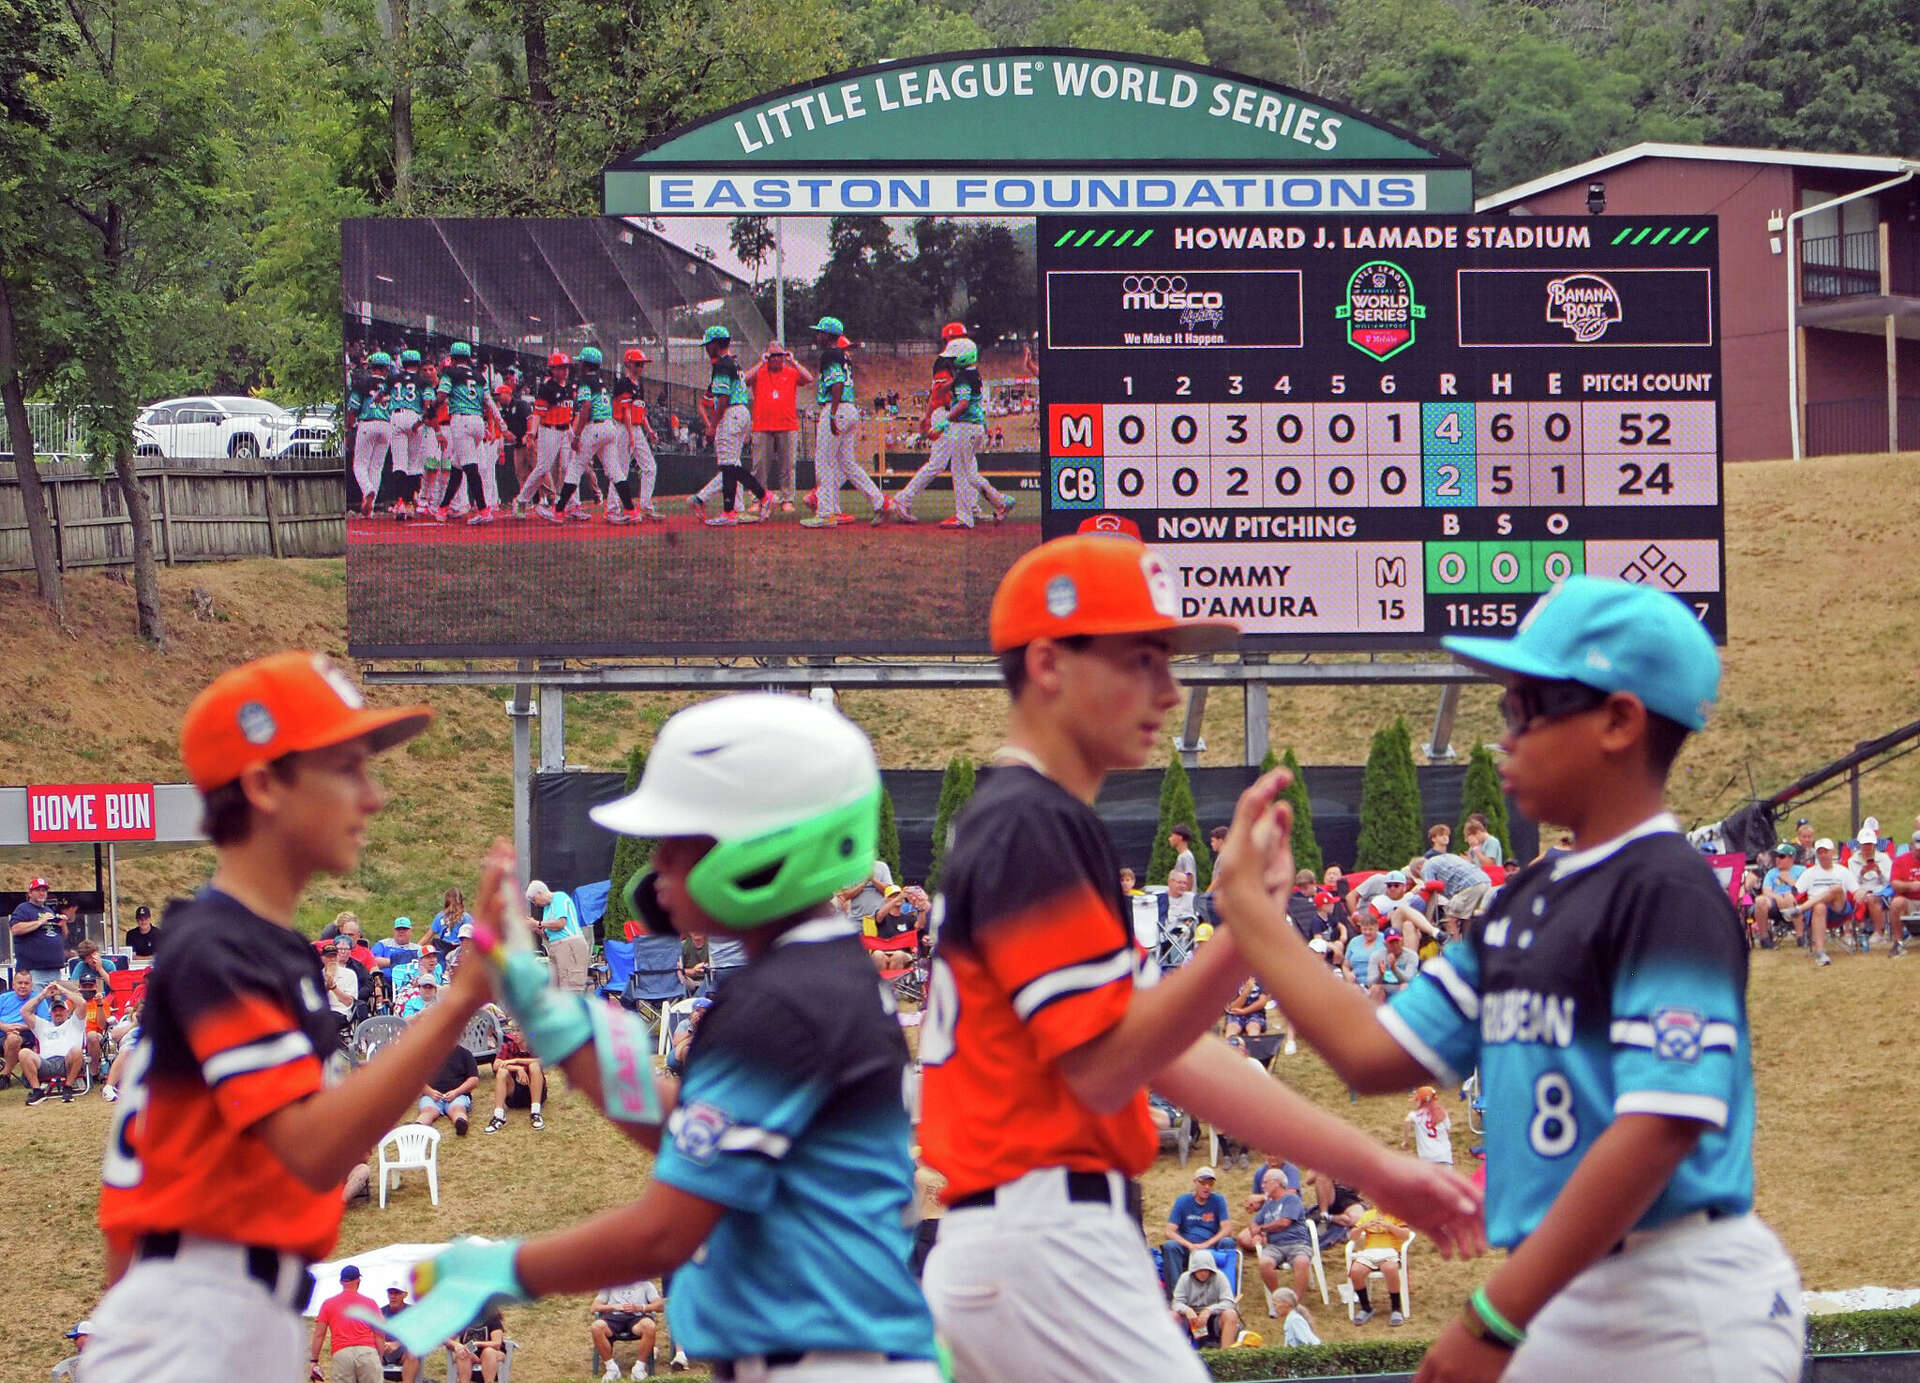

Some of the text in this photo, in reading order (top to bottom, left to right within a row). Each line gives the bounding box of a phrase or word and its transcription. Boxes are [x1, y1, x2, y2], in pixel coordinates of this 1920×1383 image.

[734, 83, 866, 154] LITTLE
[1053, 62, 1198, 109] WORLD
[1208, 83, 1342, 151] SERIES
[660, 178, 1415, 208] EASTON FOUNDATIONS
[1174, 226, 1591, 249] HOWARD J. LAMADE STADIUM
[1351, 295, 1409, 308] WORLD
[1551, 284, 1613, 305] BANANA
[1353, 309, 1408, 322] SERIES
[1124, 333, 1141, 344] We
[1143, 333, 1172, 344] Make
[1185, 333, 1224, 346] Happen
[394, 381, 416, 402] 13
[1123, 373, 1712, 395] 1 2 3 4 5 6 R H E PITCH COUNT
[1060, 412, 1671, 448] M 0 0 3 0 0 1 4 6 0 52
[1058, 463, 1674, 502] CB 0 0 2 0 0 0 2 5 1 24
[1157, 516, 1357, 539] NOW PITCHING
[1443, 513, 1460, 535] B
[1497, 513, 1512, 535] S
[1179, 566, 1292, 587] TOMMY
[1375, 556, 1406, 588] M
[1438, 552, 1467, 584] 0
[1491, 552, 1520, 584] 0
[1181, 596, 1318, 618] D'AMURA
[1378, 600, 1406, 620] 15
[1445, 604, 1517, 627] 11:55
[32, 793, 151, 831] HOME BUN
[1529, 1071, 1578, 1158] 8
